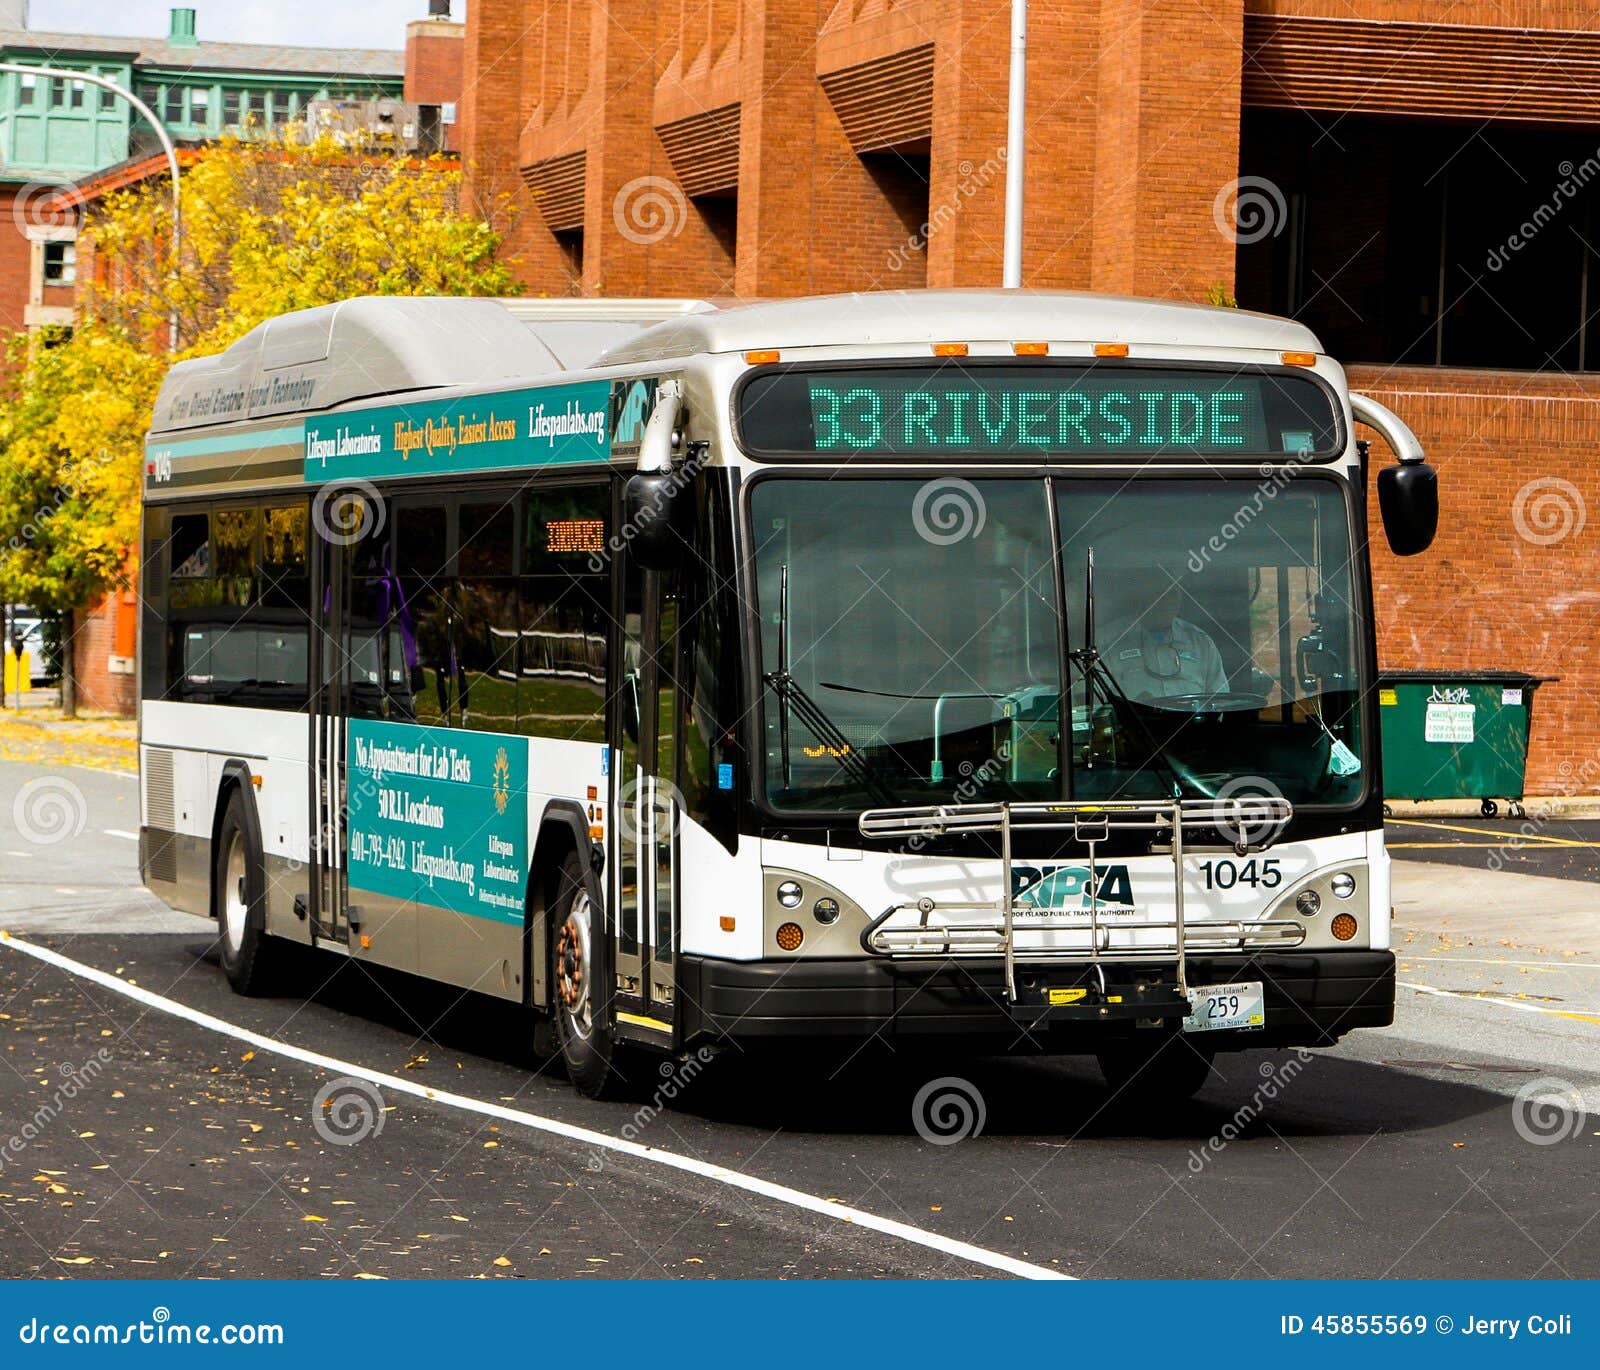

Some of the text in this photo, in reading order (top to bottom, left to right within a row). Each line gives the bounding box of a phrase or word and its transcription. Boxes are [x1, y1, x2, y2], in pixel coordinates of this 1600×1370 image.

[307, 400, 605, 468] Lifespan Laboratories Highest Quality, Easiest Access Lifespanlabs.org
[810, 388, 1244, 448] 33 RIVERSIDE
[355, 737, 471, 784] No Appointment for Lab Tests
[378, 789, 389, 819] 50
[404, 791, 444, 829] Locations
[488, 834, 514, 859] Lifespan
[411, 840, 475, 897] Lifespanlabs.org
[1200, 859, 1282, 889] 1045
[1049, 910, 1072, 918] PUBLIC
[1073, 909, 1098, 917] TRANST
[1200, 985, 1245, 997] Rhode Island
[1207, 995, 1239, 1019] 259
